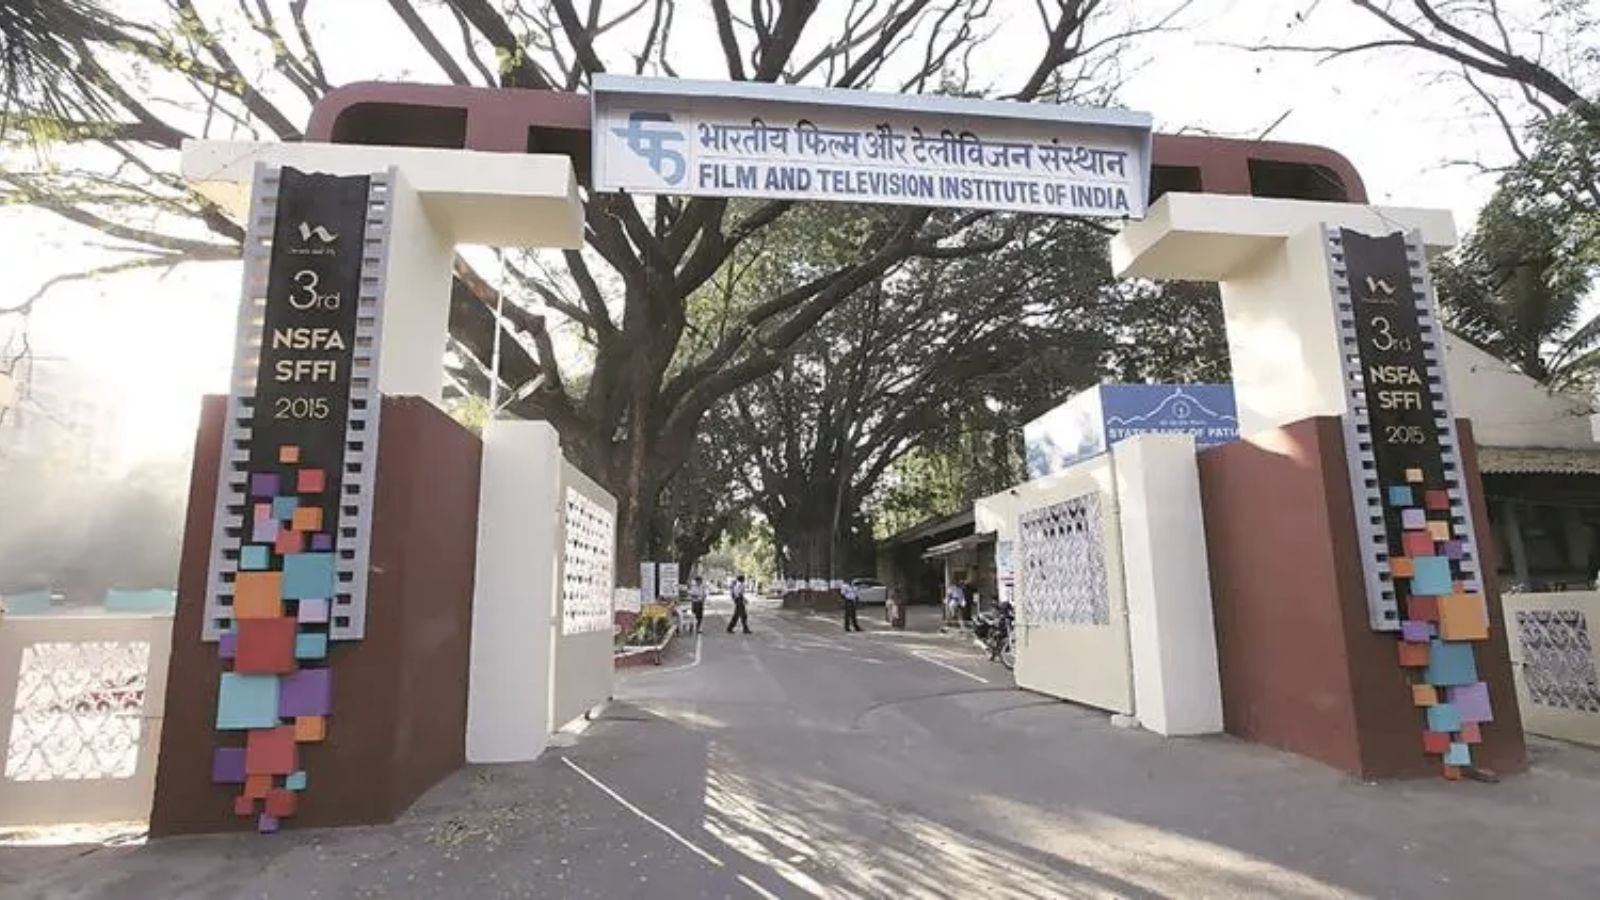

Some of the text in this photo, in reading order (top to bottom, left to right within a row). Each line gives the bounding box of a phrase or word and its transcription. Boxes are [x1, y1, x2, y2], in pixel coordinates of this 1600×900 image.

[699, 116, 1127, 177] भारतीय फिल्म और टेलीविजन संस्थान
[700, 163, 1129, 211] FILM AND TELEVISION INSTITUTE OF INDIA
[289, 270, 341, 310] 3rd
[272, 328, 345, 350] NSFA
[1371, 316, 1411, 351] 3rd
[275, 360, 337, 382] SFFI
[1369, 366, 1422, 385] NSFA
[274, 398, 330, 420] 2015
[1378, 391, 1422, 410] SFFI
[1386, 426, 1425, 443] 2015
